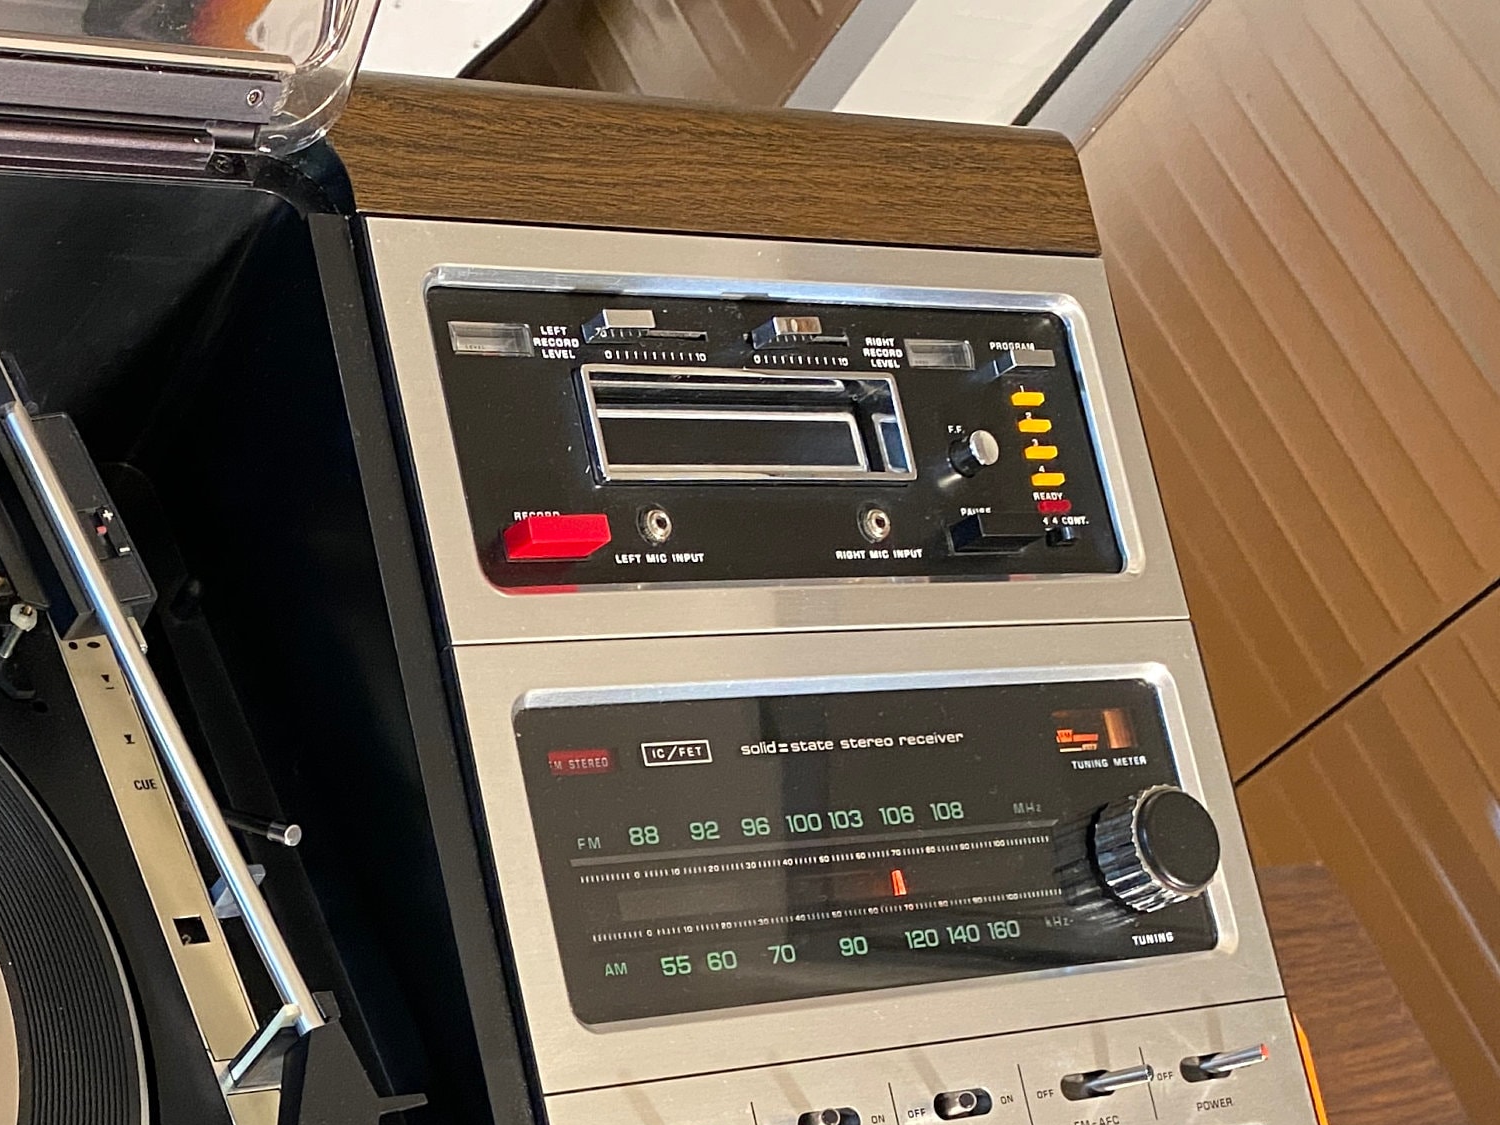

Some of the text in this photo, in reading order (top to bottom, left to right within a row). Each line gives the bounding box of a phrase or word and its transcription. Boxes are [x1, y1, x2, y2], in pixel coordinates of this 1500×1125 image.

[540, 326, 567, 336] LEFT
[533, 337, 580, 348] RECORD
[865, 337, 895, 347] RIGHT
[989, 341, 1035, 351] PROGRAM
[543, 349, 576, 359] LEVEL
[862, 348, 903, 358] RECORD
[871, 359, 900, 368] LEVEL
[1033, 492, 1063, 500] READY
[615, 553, 704, 564] LEFT MIC INPUT
[835, 549, 922, 560] RIGHT MIC INPUT
[840, 735, 894, 749] stereo
[899, 731, 964, 747] receiver
[652, 746, 702, 760] IC/FET
[569, 757, 609, 770] STEREO
[1071, 755, 1147, 770] TUNING METER
[133, 778, 158, 792] CUE
[577, 801, 1042, 850] FM 88 92 96 100 103 106 108 MHz
[672, 867, 680, 876] 10
[708, 864, 720, 873] 20
[746, 861, 757, 870] 30
[782, 858, 793, 867] 40
[890, 848, 901, 857] 70
[684, 925, 693, 934] 10
[721, 921, 732, 930] 20
[758, 917, 769, 926] 30
[904, 903, 914, 911] 70
[1132, 931, 1174, 946] TUNING
[605, 962, 628, 977] AM
[660, 955, 692, 976] 55
[706, 950, 738, 971] 60
[767, 944, 796, 965] 70
[838, 936, 868, 957] 90
[905, 928, 940, 949] 120
[946, 924, 981, 945] 140
[987, 920, 1021, 940] 160
[1157, 1070, 1174, 1081] OFF
[1036, 1088, 1055, 1100] OFF
[907, 1093, 1015, 1119] OFF ON
[1196, 1096, 1234, 1112] POWER
[870, 1114, 886, 1125] ON
